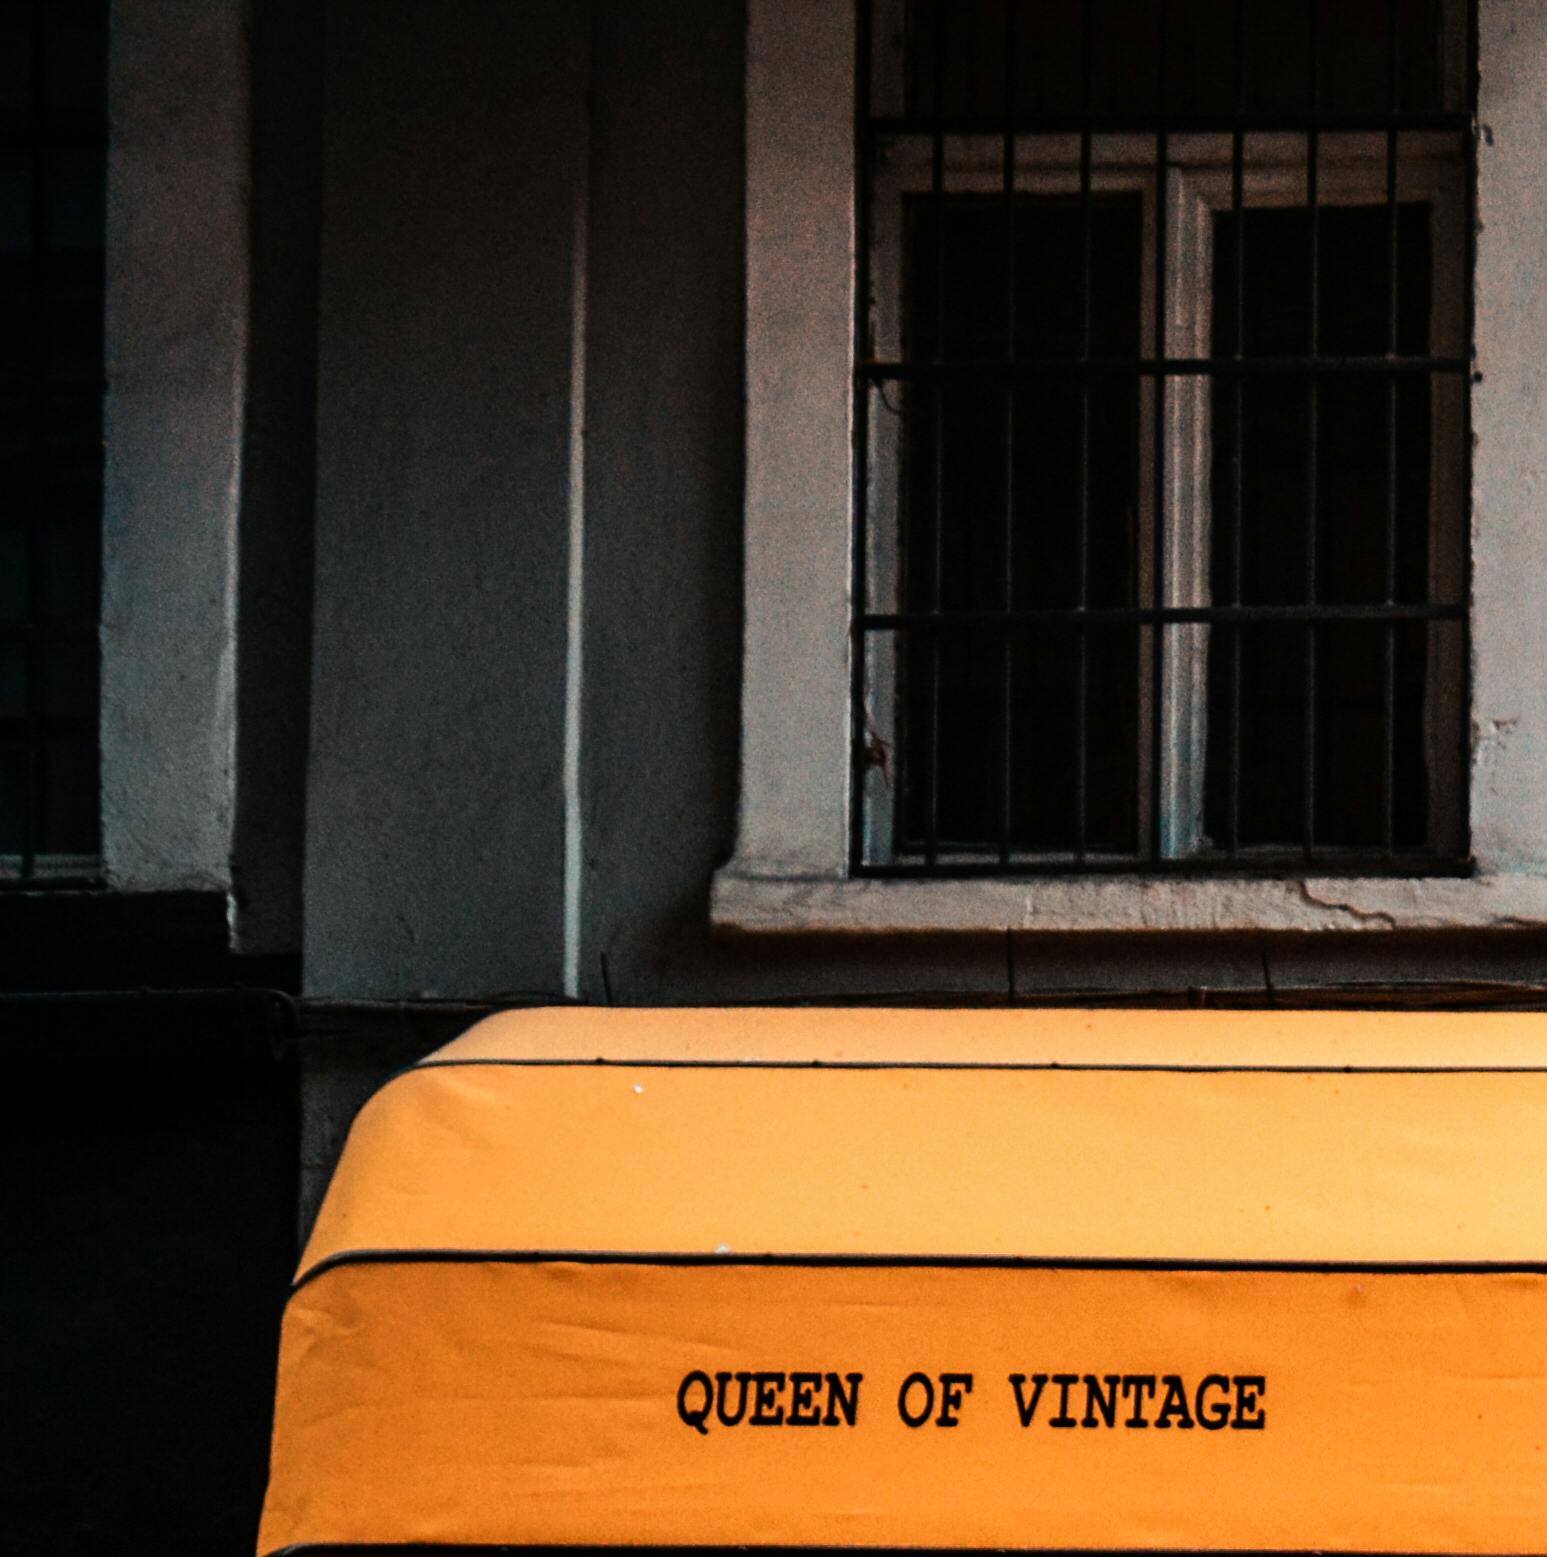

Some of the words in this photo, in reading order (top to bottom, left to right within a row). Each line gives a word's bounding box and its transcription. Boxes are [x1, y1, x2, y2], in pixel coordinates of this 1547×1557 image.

[677, 1369, 863, 1435] QUEEN
[898, 1371, 973, 1429] OF
[1008, 1373, 1266, 1431] VINTAGE
